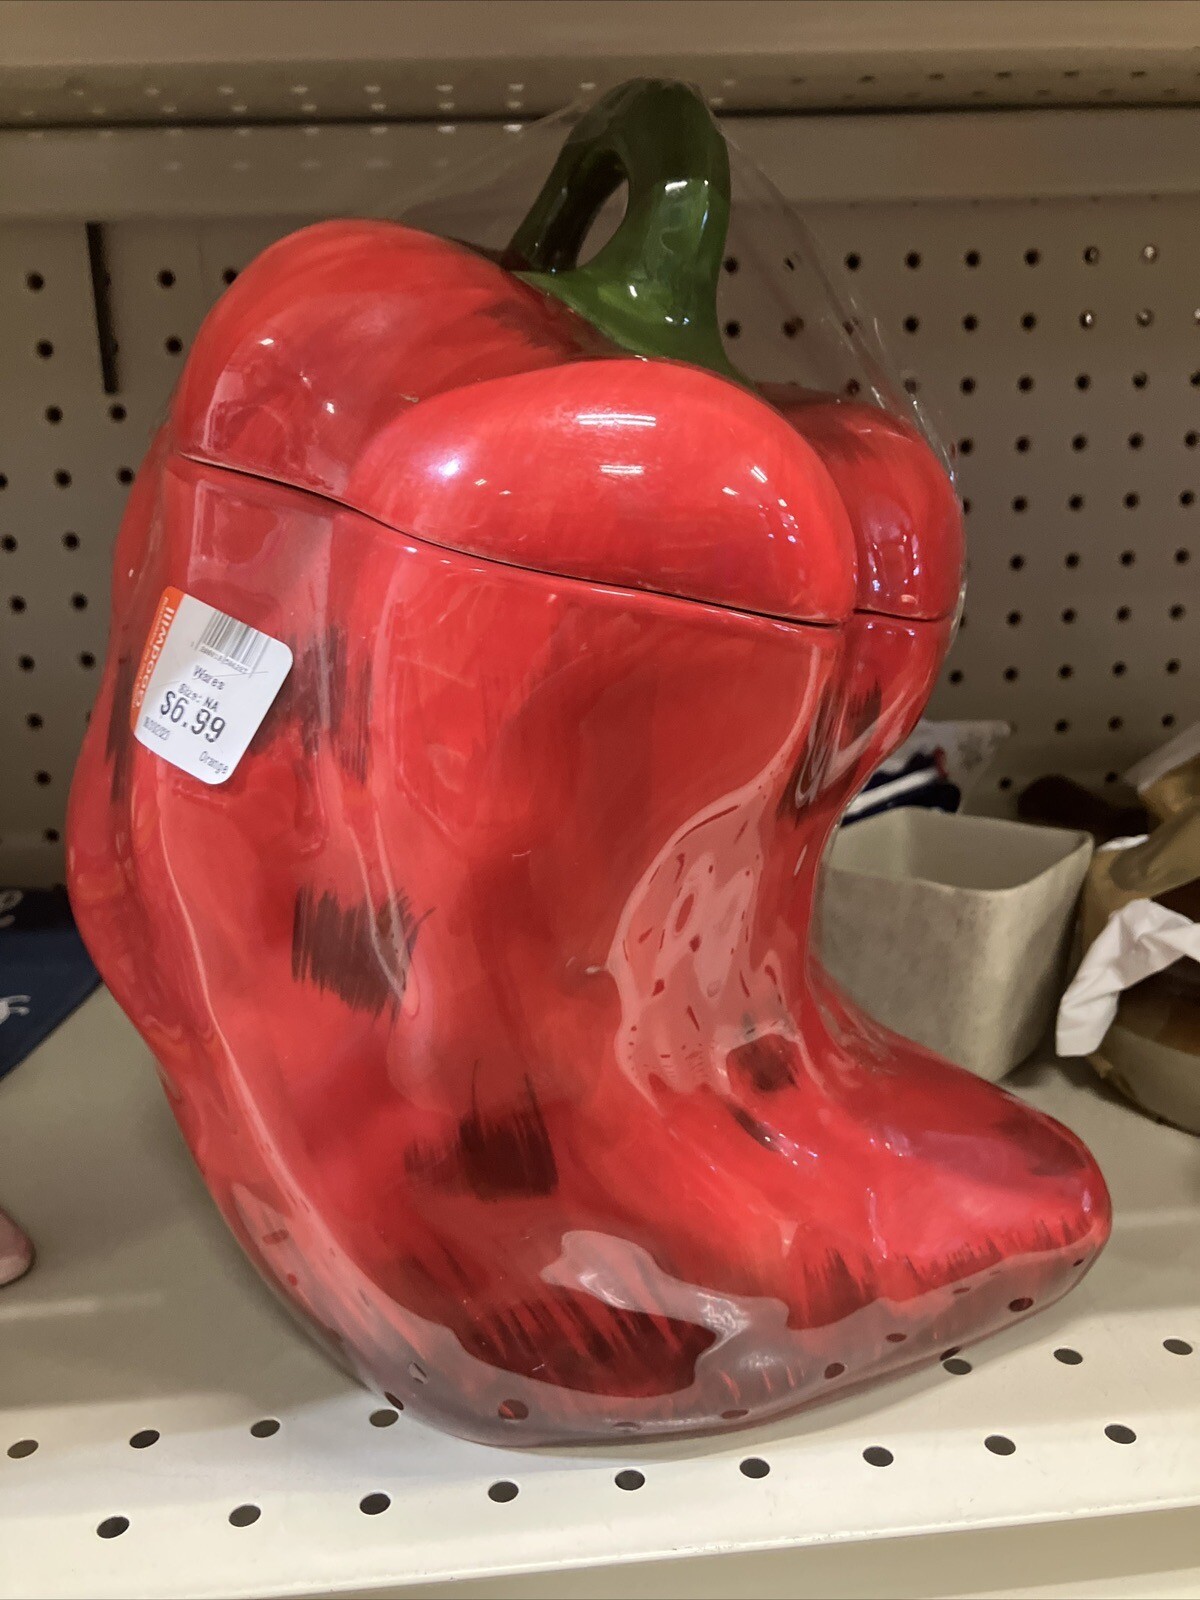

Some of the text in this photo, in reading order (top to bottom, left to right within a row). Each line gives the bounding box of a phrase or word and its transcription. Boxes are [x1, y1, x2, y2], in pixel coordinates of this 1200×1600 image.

[192, 664, 225, 690] Wares
[160, 690, 226, 743] $6.99
[204, 697, 219, 712] NA
[199, 751, 229, 774] Orange
